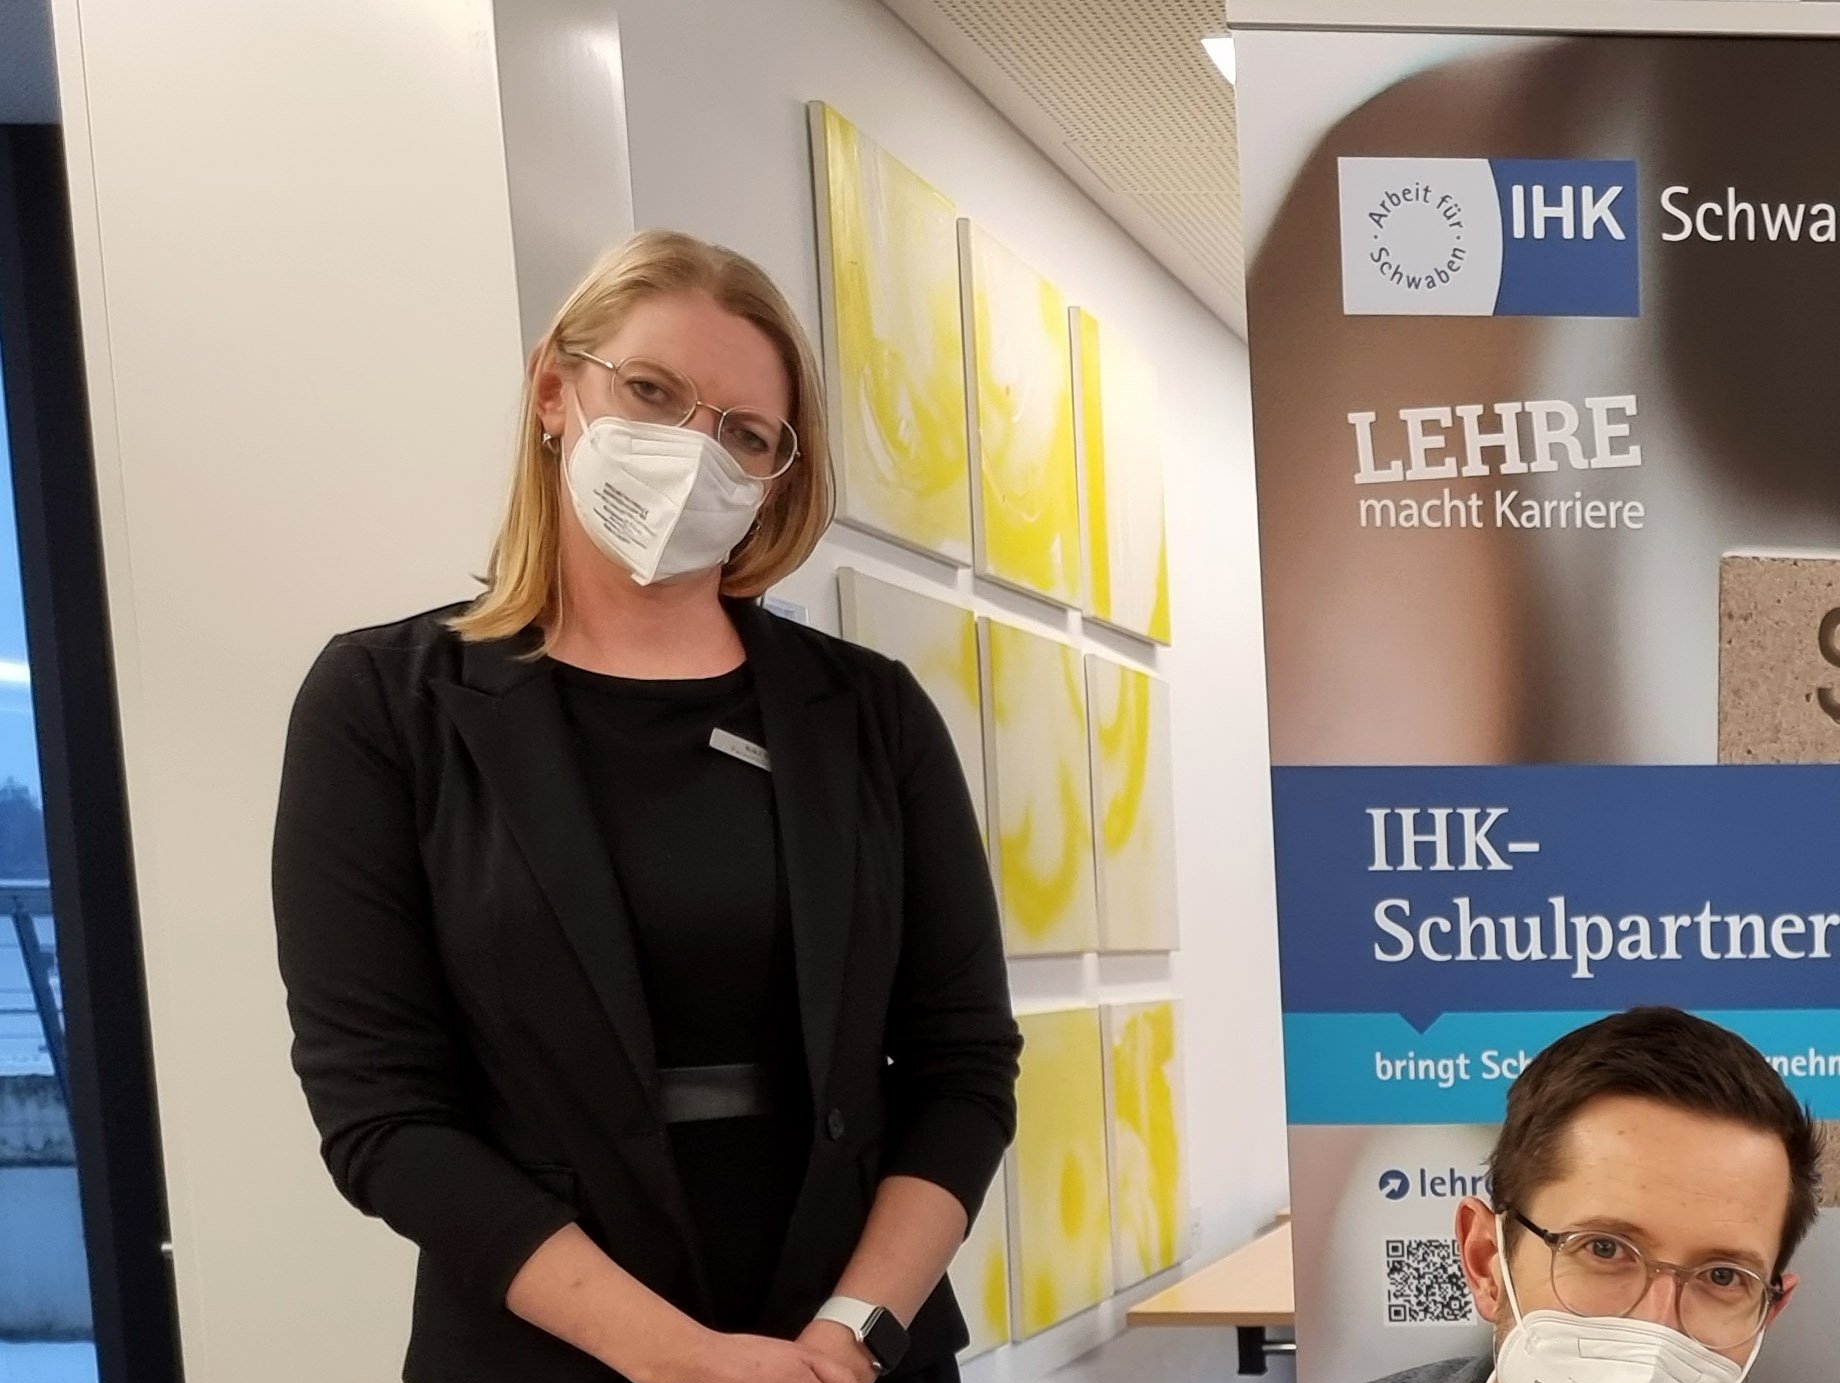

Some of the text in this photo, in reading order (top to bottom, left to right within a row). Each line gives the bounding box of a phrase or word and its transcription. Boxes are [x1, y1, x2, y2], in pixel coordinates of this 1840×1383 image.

[1368, 182, 1464, 229] Arbeit für
[1512, 184, 1626, 240] IHK
[1370, 246, 1466, 290] Schwaben
[1348, 394, 1643, 485] LEHRE
[1358, 492, 1646, 531] macht Karriere
[1366, 807, 1541, 872] IHK-
[1375, 1051, 1471, 1088] bringt
